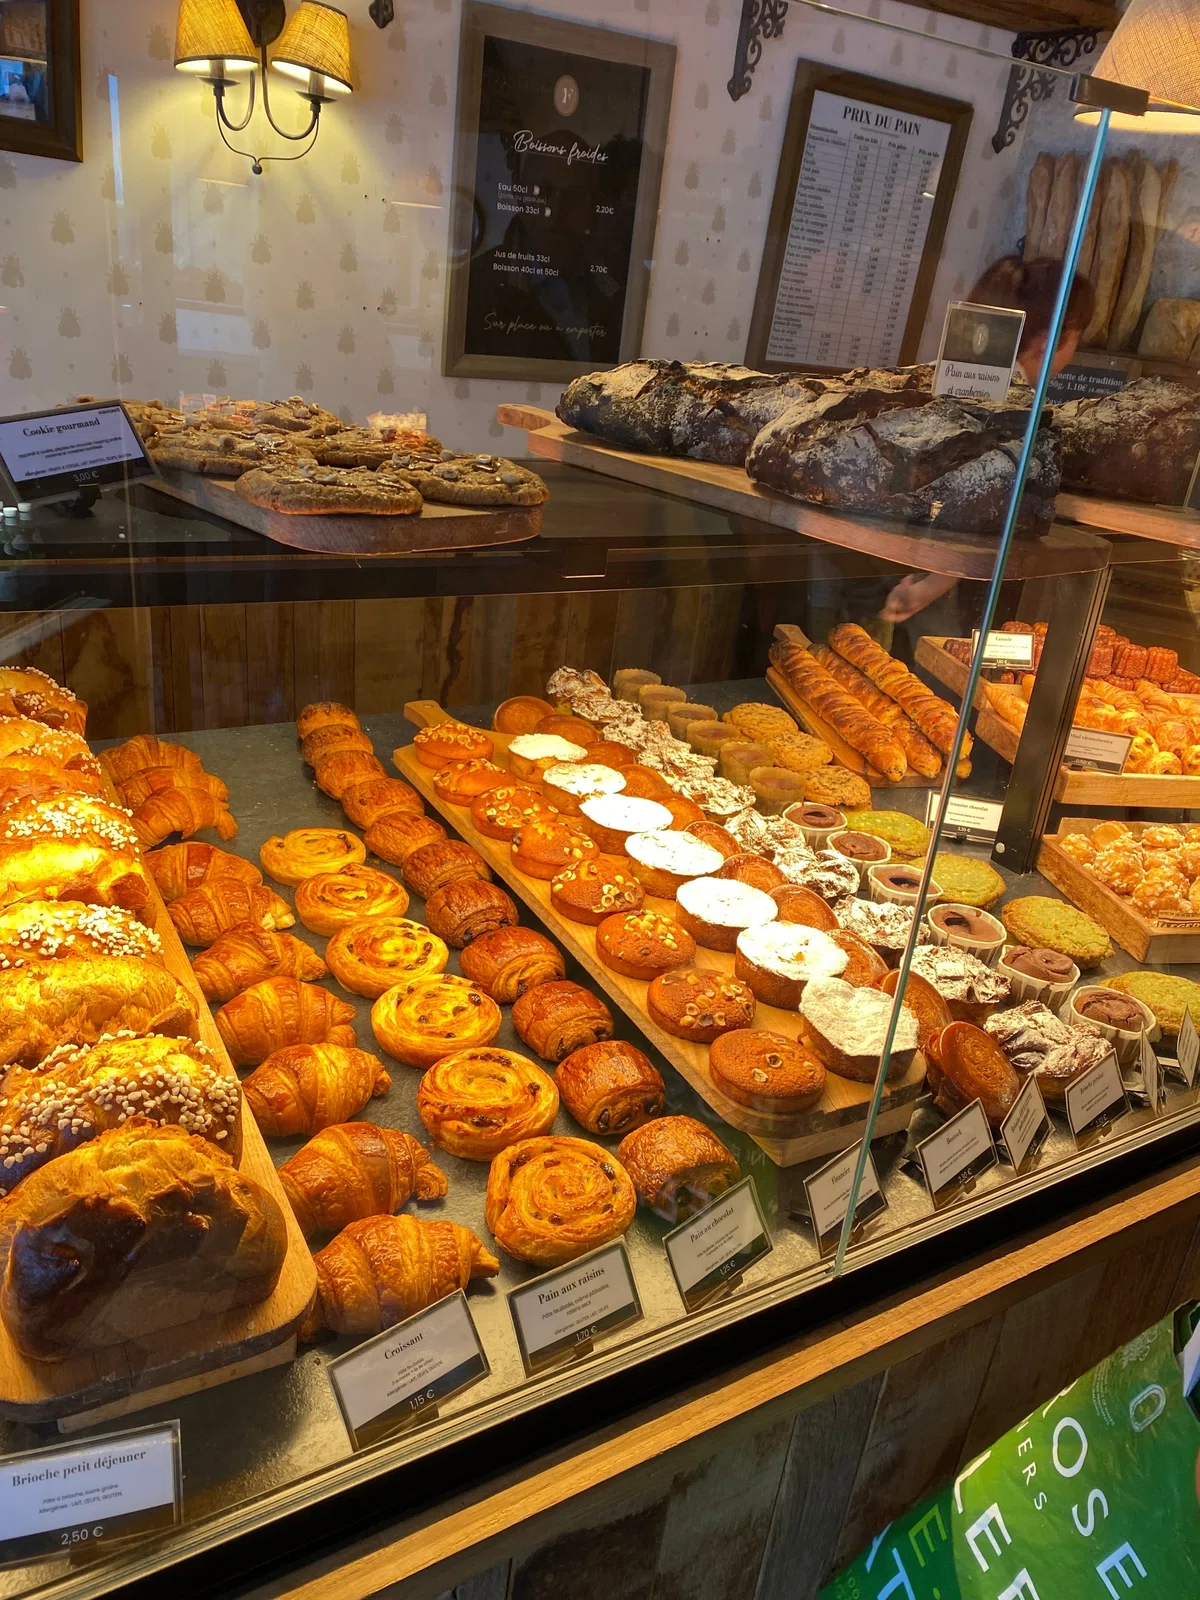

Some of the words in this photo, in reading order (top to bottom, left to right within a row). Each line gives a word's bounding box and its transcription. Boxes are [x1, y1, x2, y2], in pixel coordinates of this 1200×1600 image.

[842, 106, 870, 125] PRIX
[874, 113, 892, 129] DU
[894, 118, 921, 136] PAIN
[513, 130, 566, 153] Boissons
[567, 142, 608, 165] froides
[498, 183, 512, 192] Eau
[513, 184, 528, 193] 50cl
[497, 202, 524, 212] Boisson
[525, 206, 540, 214] 33cl
[596, 205, 615, 214] 2,20€
[494, 250, 506, 258] Jus
[518, 253, 535, 261] fruits
[493, 263, 519, 272] Boisson
[521, 266, 536, 274] 40cl
[590, 265, 608, 274] 2,70€
[484, 312, 506, 330] Sur
[506, 315, 536, 334] place
[566, 321, 607, 340] emporter
[945, 363, 962, 378] Pain
[978, 372, 1000, 382] raisins
[1078, 374, 1088, 382] de
[1089, 376, 1123, 387] tradition
[955, 386, 991, 398] cranberries
[1066, 383, 1088, 392] 1.10€
[22, 424, 55, 437] Cookie
[56, 417, 100, 434] gourmand
[73, 471, 90, 482] 3,00
[690, 1230, 704, 1243] Pain
[704, 1225, 712, 1233] au
[711, 1207, 734, 1228] chocolat
[730, 1260, 736, 1268] €
[538, 1290, 560, 1305] Pain
[561, 1281, 577, 1294] aux
[578, 1267, 605, 1286] raisins
[591, 1325, 597, 1333] €
[384, 1332, 423, 1360] Croissant
[409, 1395, 425, 1410] 1,15
[426, 1389, 435, 1399] €
[12, 1469, 60, 1487] Brioche
[63, 1461, 91, 1479] petit
[93, 1450, 147, 1470] déjeuner
[61, 1529, 89, 1546] 2,50
[92, 1526, 104, 1538] €
